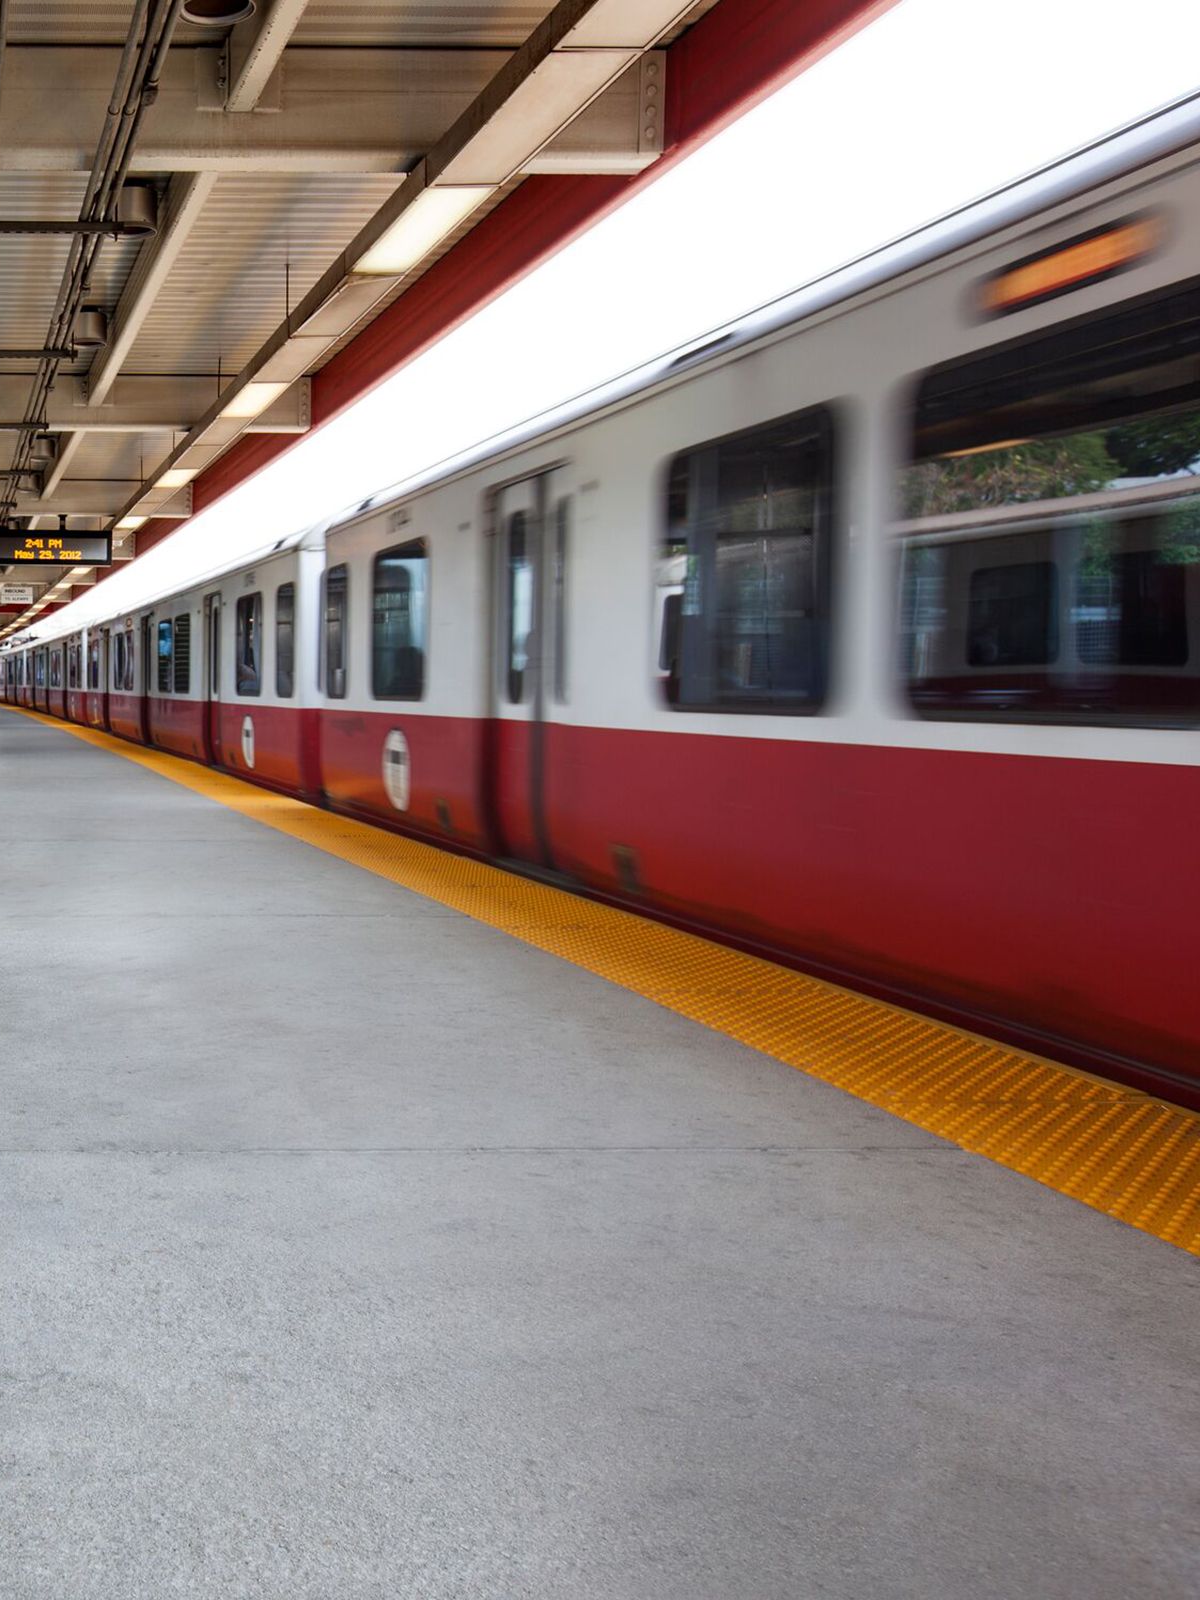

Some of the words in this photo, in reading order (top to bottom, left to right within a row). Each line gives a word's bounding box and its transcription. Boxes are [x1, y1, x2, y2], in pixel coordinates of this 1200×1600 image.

[25, 538, 43, 548] 2:41
[48, 539, 63, 548] PM
[14, 550, 35, 559] May
[59, 551, 82, 560] 2012
